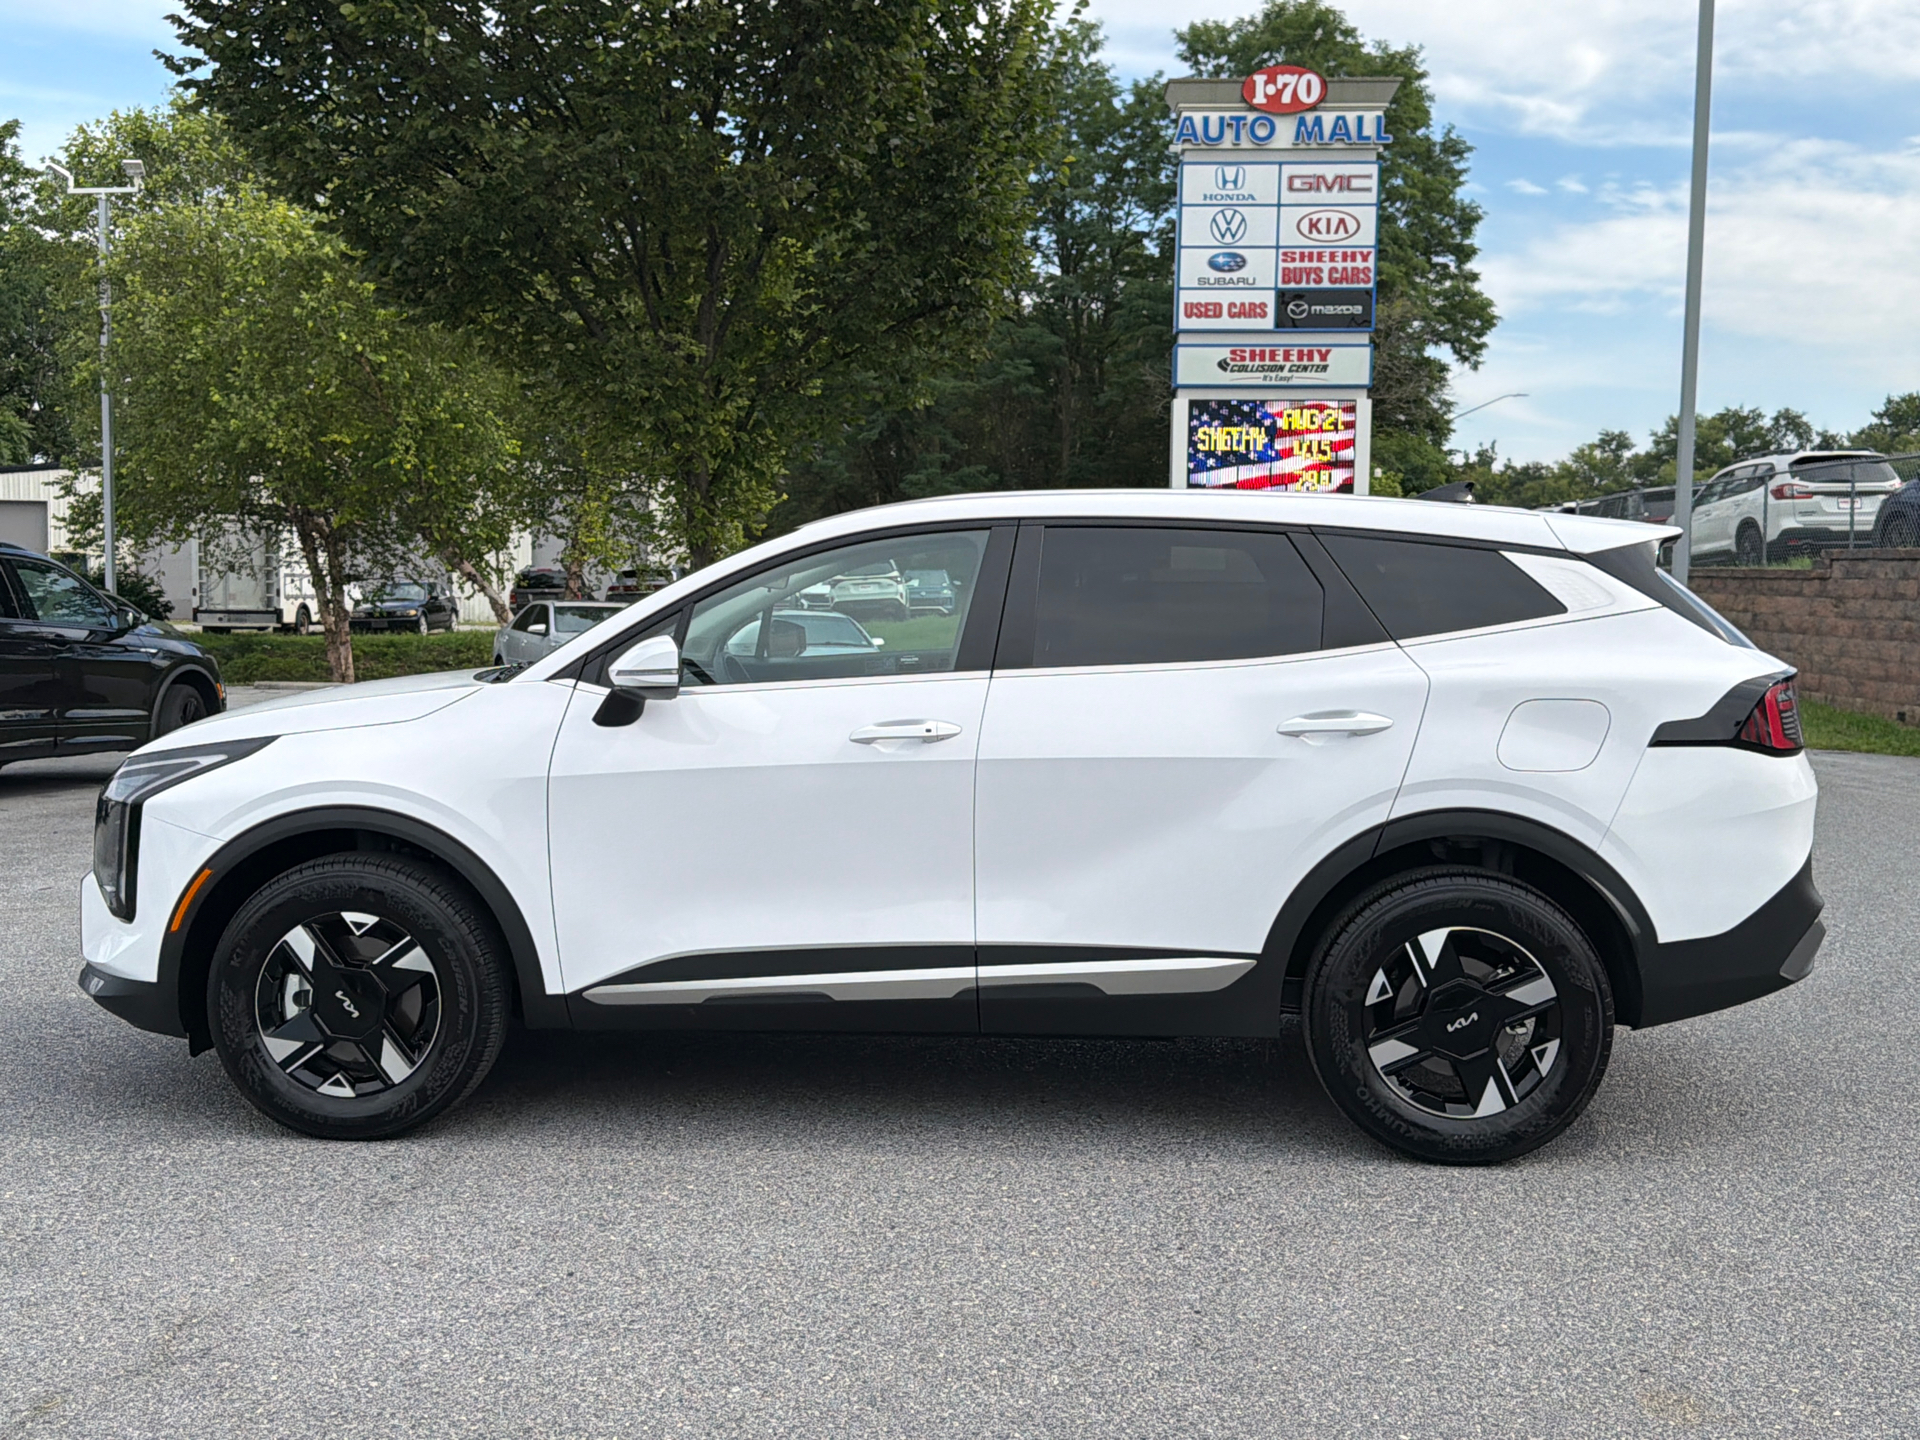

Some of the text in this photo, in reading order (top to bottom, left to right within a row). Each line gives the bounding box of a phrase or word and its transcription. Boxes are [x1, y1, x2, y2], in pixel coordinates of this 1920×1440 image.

[1173, 114, 1393, 145] AUTO MALL
[1287, 173, 1373, 193] GMC
[1203, 193, 1256, 201] HONDA
[1308, 217, 1349, 235] KIA
[1281, 250, 1372, 263] SHEEHY
[1197, 277, 1256, 286] SUBARU
[1281, 267, 1372, 285] BUYS CARS
[1183, 301, 1268, 319] USED CARS
[1311, 305, 1363, 315] mazda
[1229, 348, 1332, 362] SHEEHY
[1229, 364, 1329, 373] COLLISION CENTER
[1262, 374, 1294, 383] It's Easy!
[1282, 408, 1319, 430] AUG
[1197, 426, 1266, 452] SHEEHY
